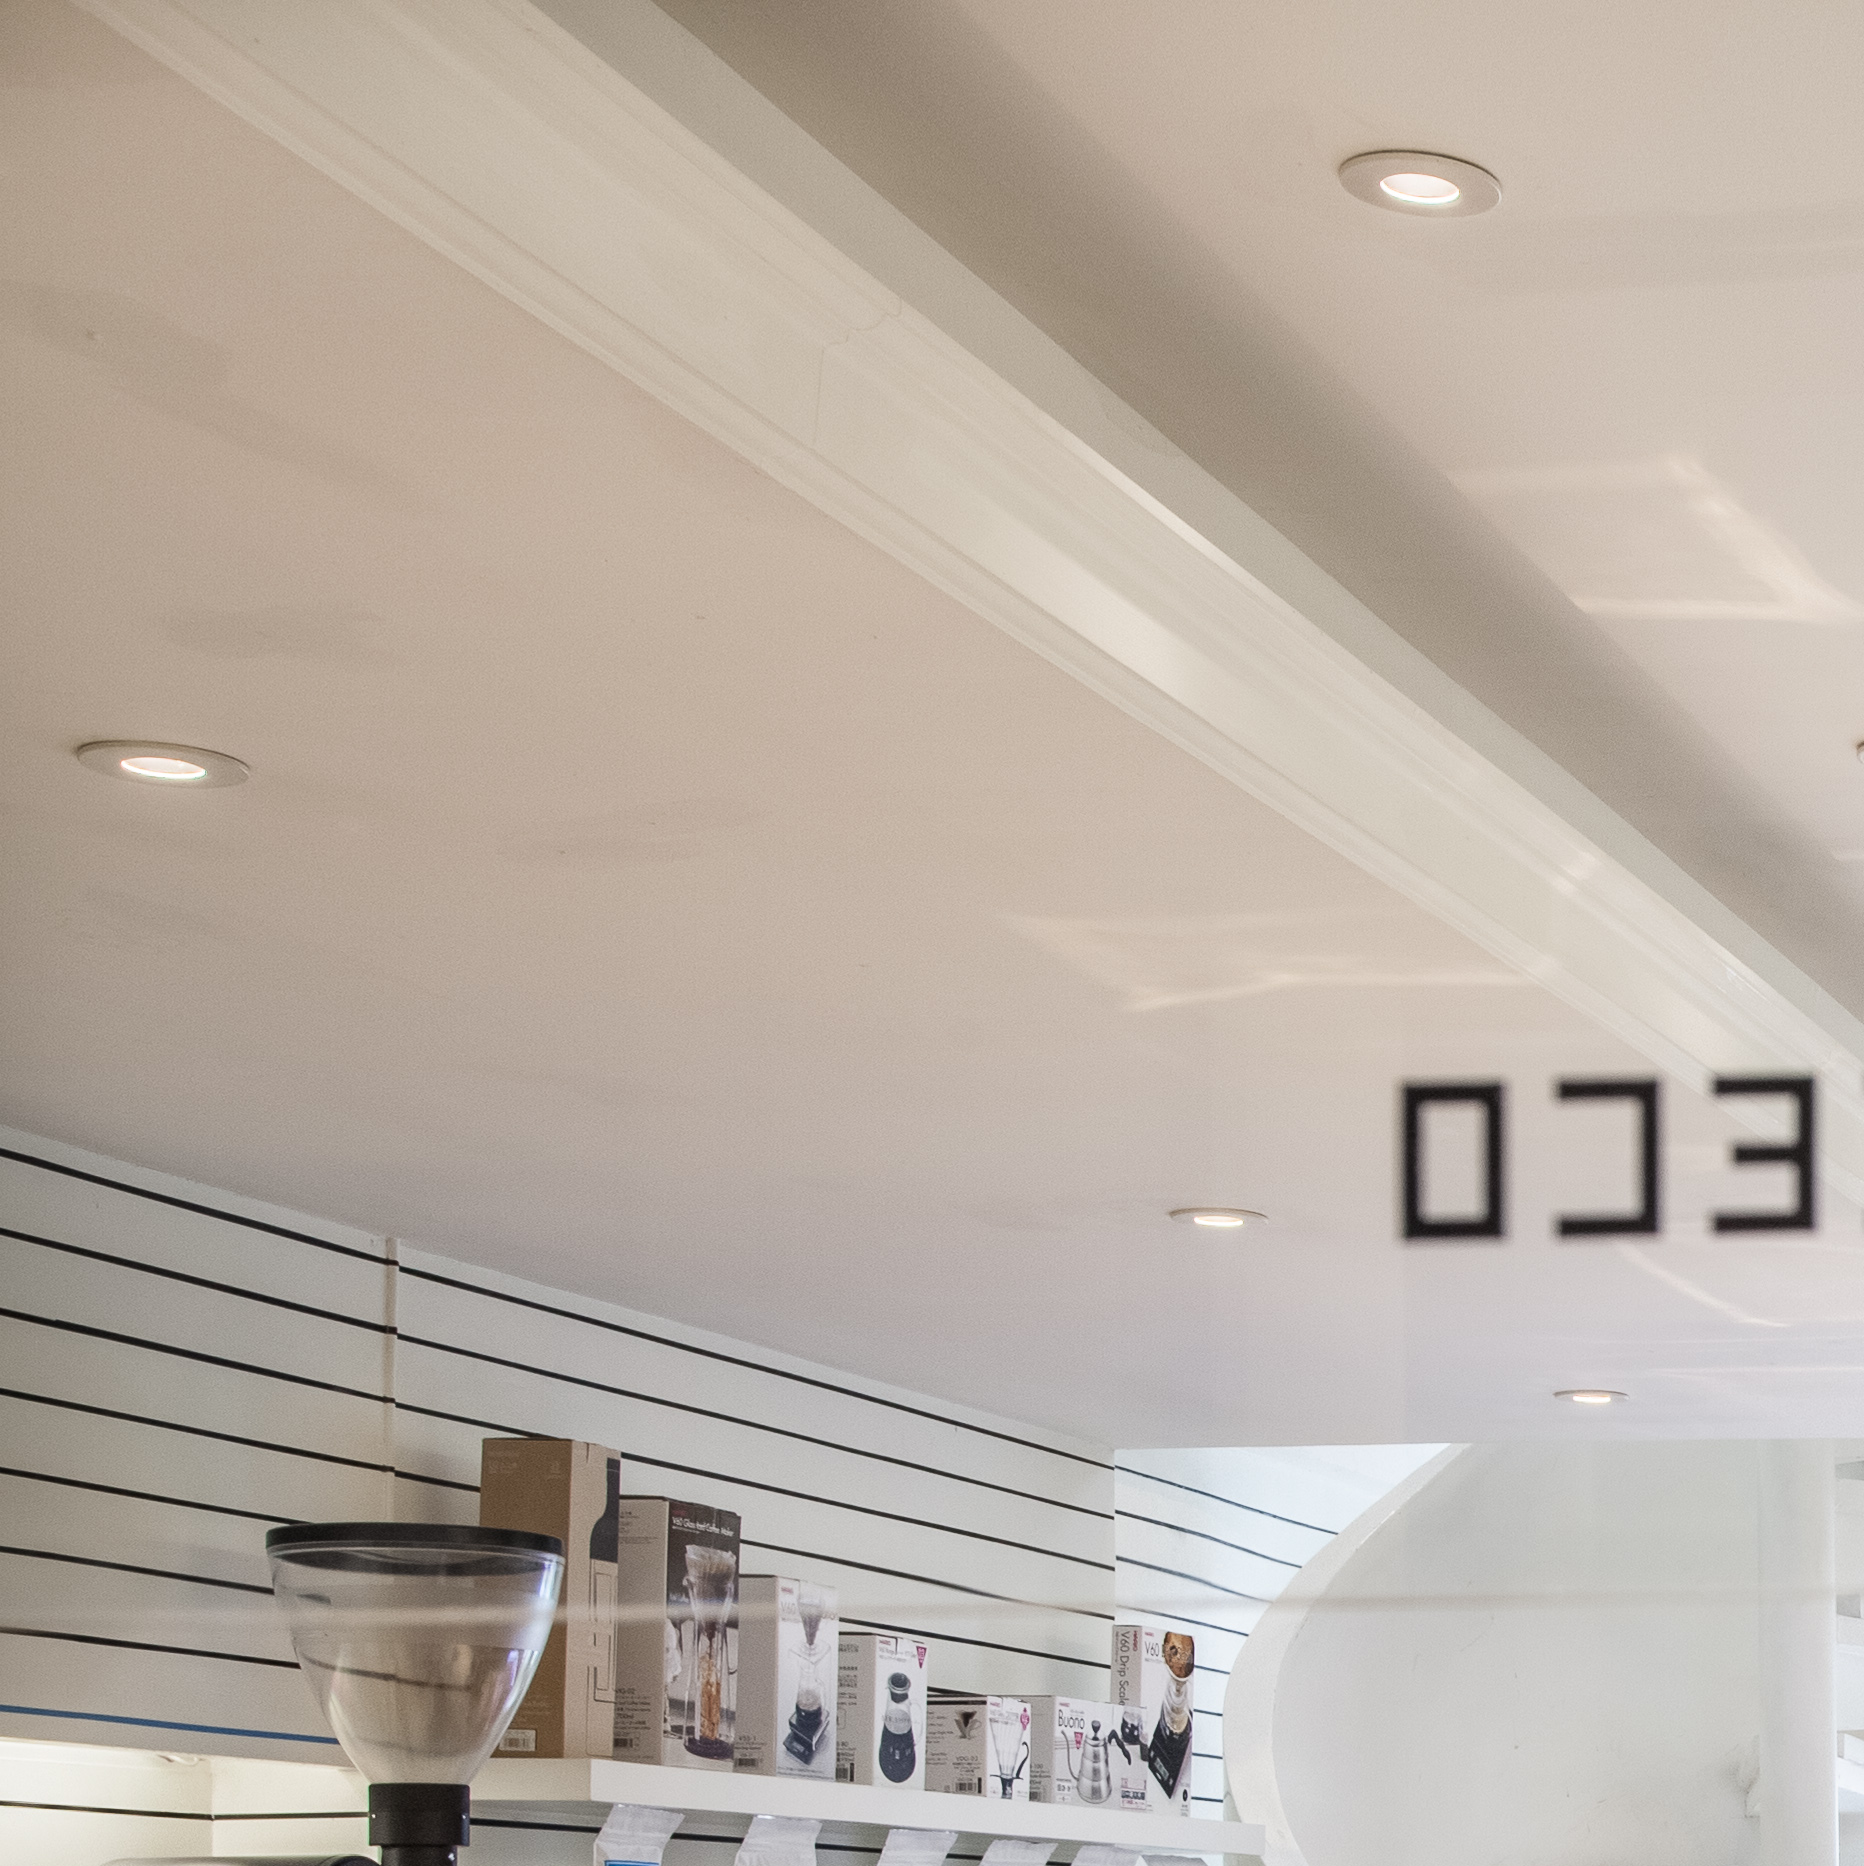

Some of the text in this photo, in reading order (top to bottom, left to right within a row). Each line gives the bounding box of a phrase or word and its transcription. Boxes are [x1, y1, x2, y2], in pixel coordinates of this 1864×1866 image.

[1120, 1631, 1130, 1652] V60
[1145, 1641, 1160, 1657] V60
[1117, 1655, 1129, 1677] Drip
[1058, 1709, 1085, 1730] Buono
